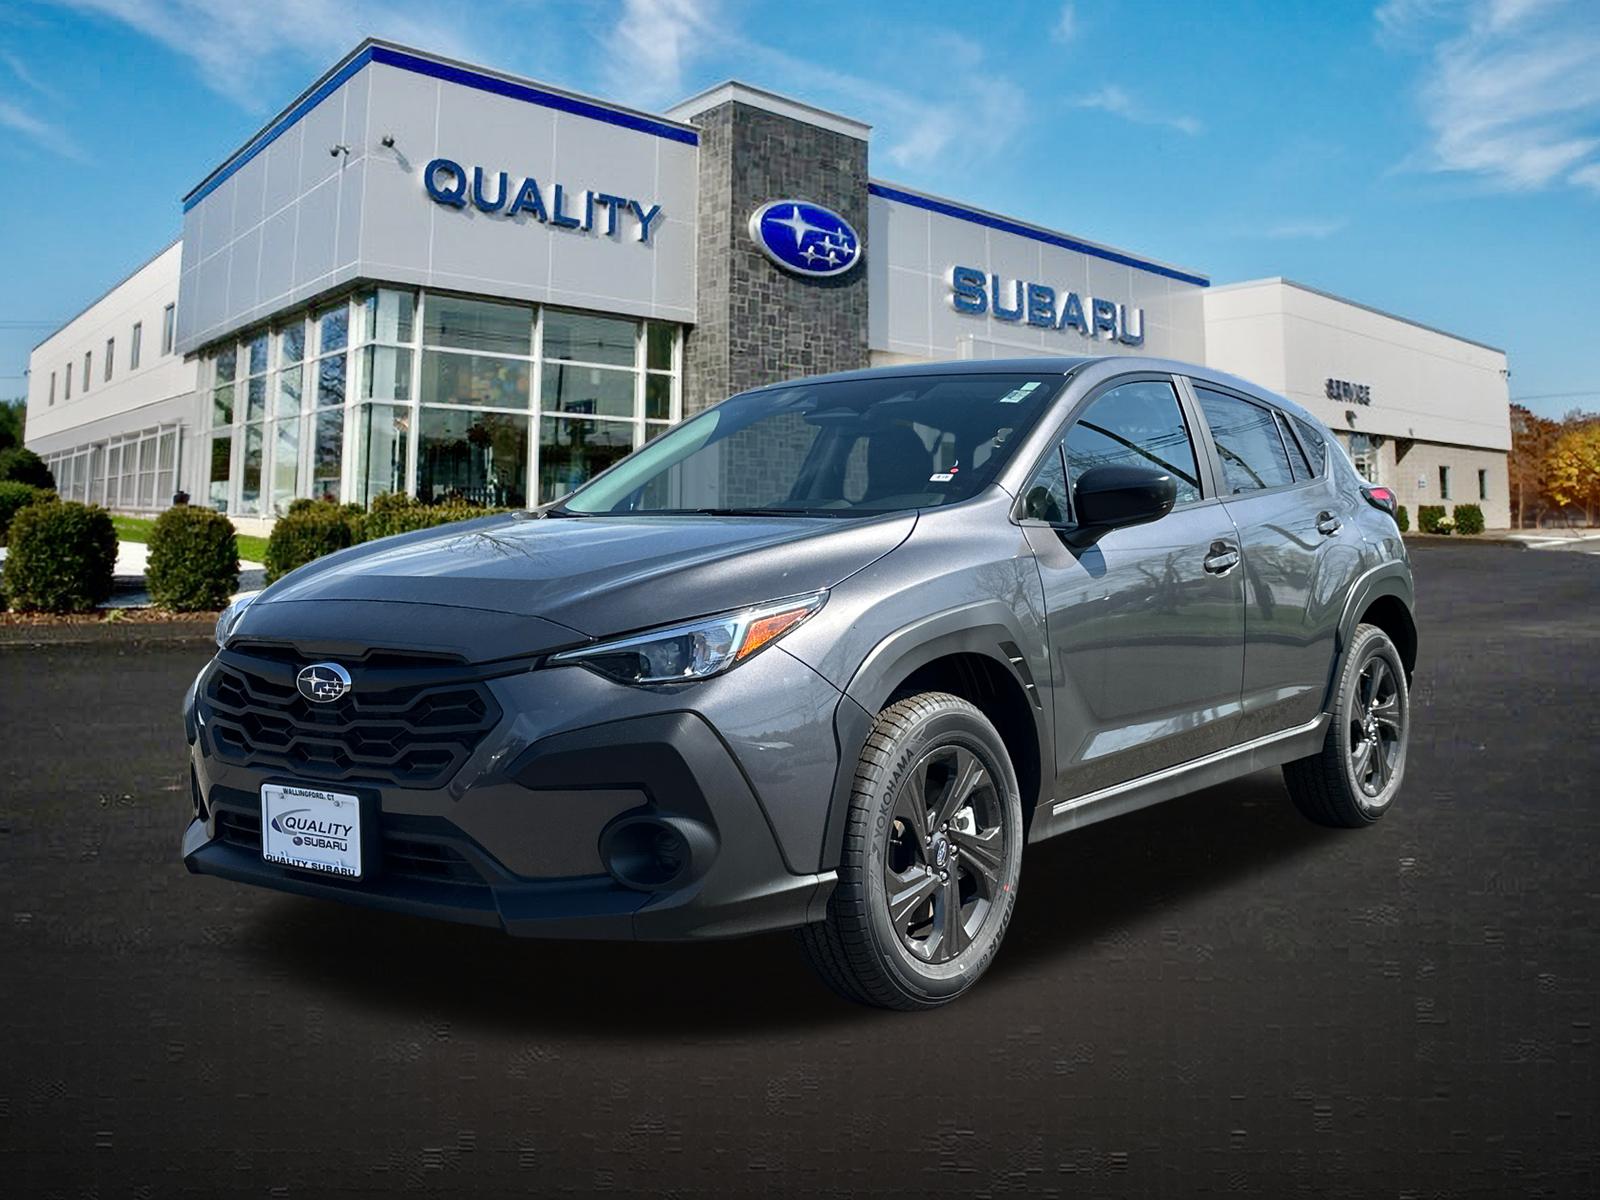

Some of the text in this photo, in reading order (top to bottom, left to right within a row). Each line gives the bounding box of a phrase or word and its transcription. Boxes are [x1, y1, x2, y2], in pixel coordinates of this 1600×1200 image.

[423, 158, 662, 242] QUALITY
[951, 265, 1145, 346] SUBARU
[874, 748, 915, 838] YOKOHAMA
[285, 816, 353, 837] QUALITY
[303, 836, 348, 852] SUBARU
[265, 854, 356, 877] QUALITY SUBARU
